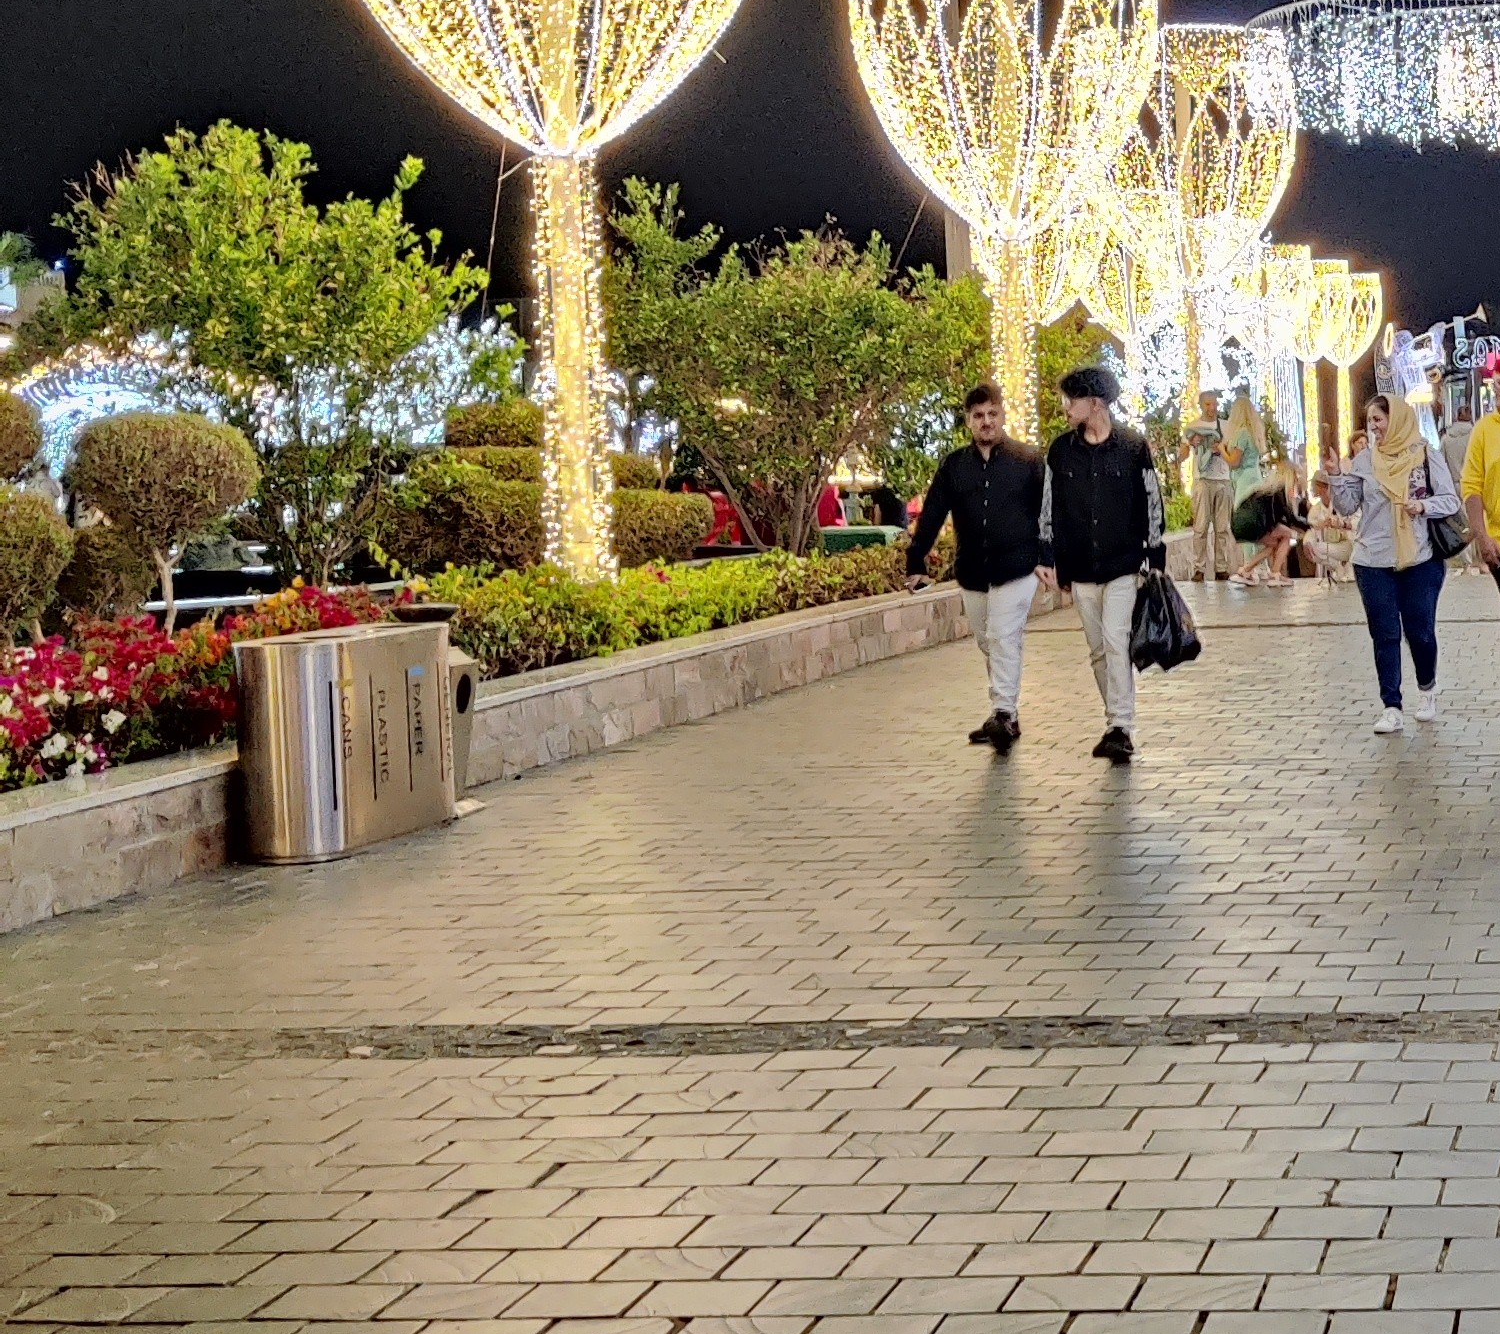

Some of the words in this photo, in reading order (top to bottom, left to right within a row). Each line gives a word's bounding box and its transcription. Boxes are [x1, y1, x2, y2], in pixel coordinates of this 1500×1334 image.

[341, 696, 352, 759] CANS
[378, 689, 389, 783] PLASTIC
[413, 682, 423, 756] PAPER
